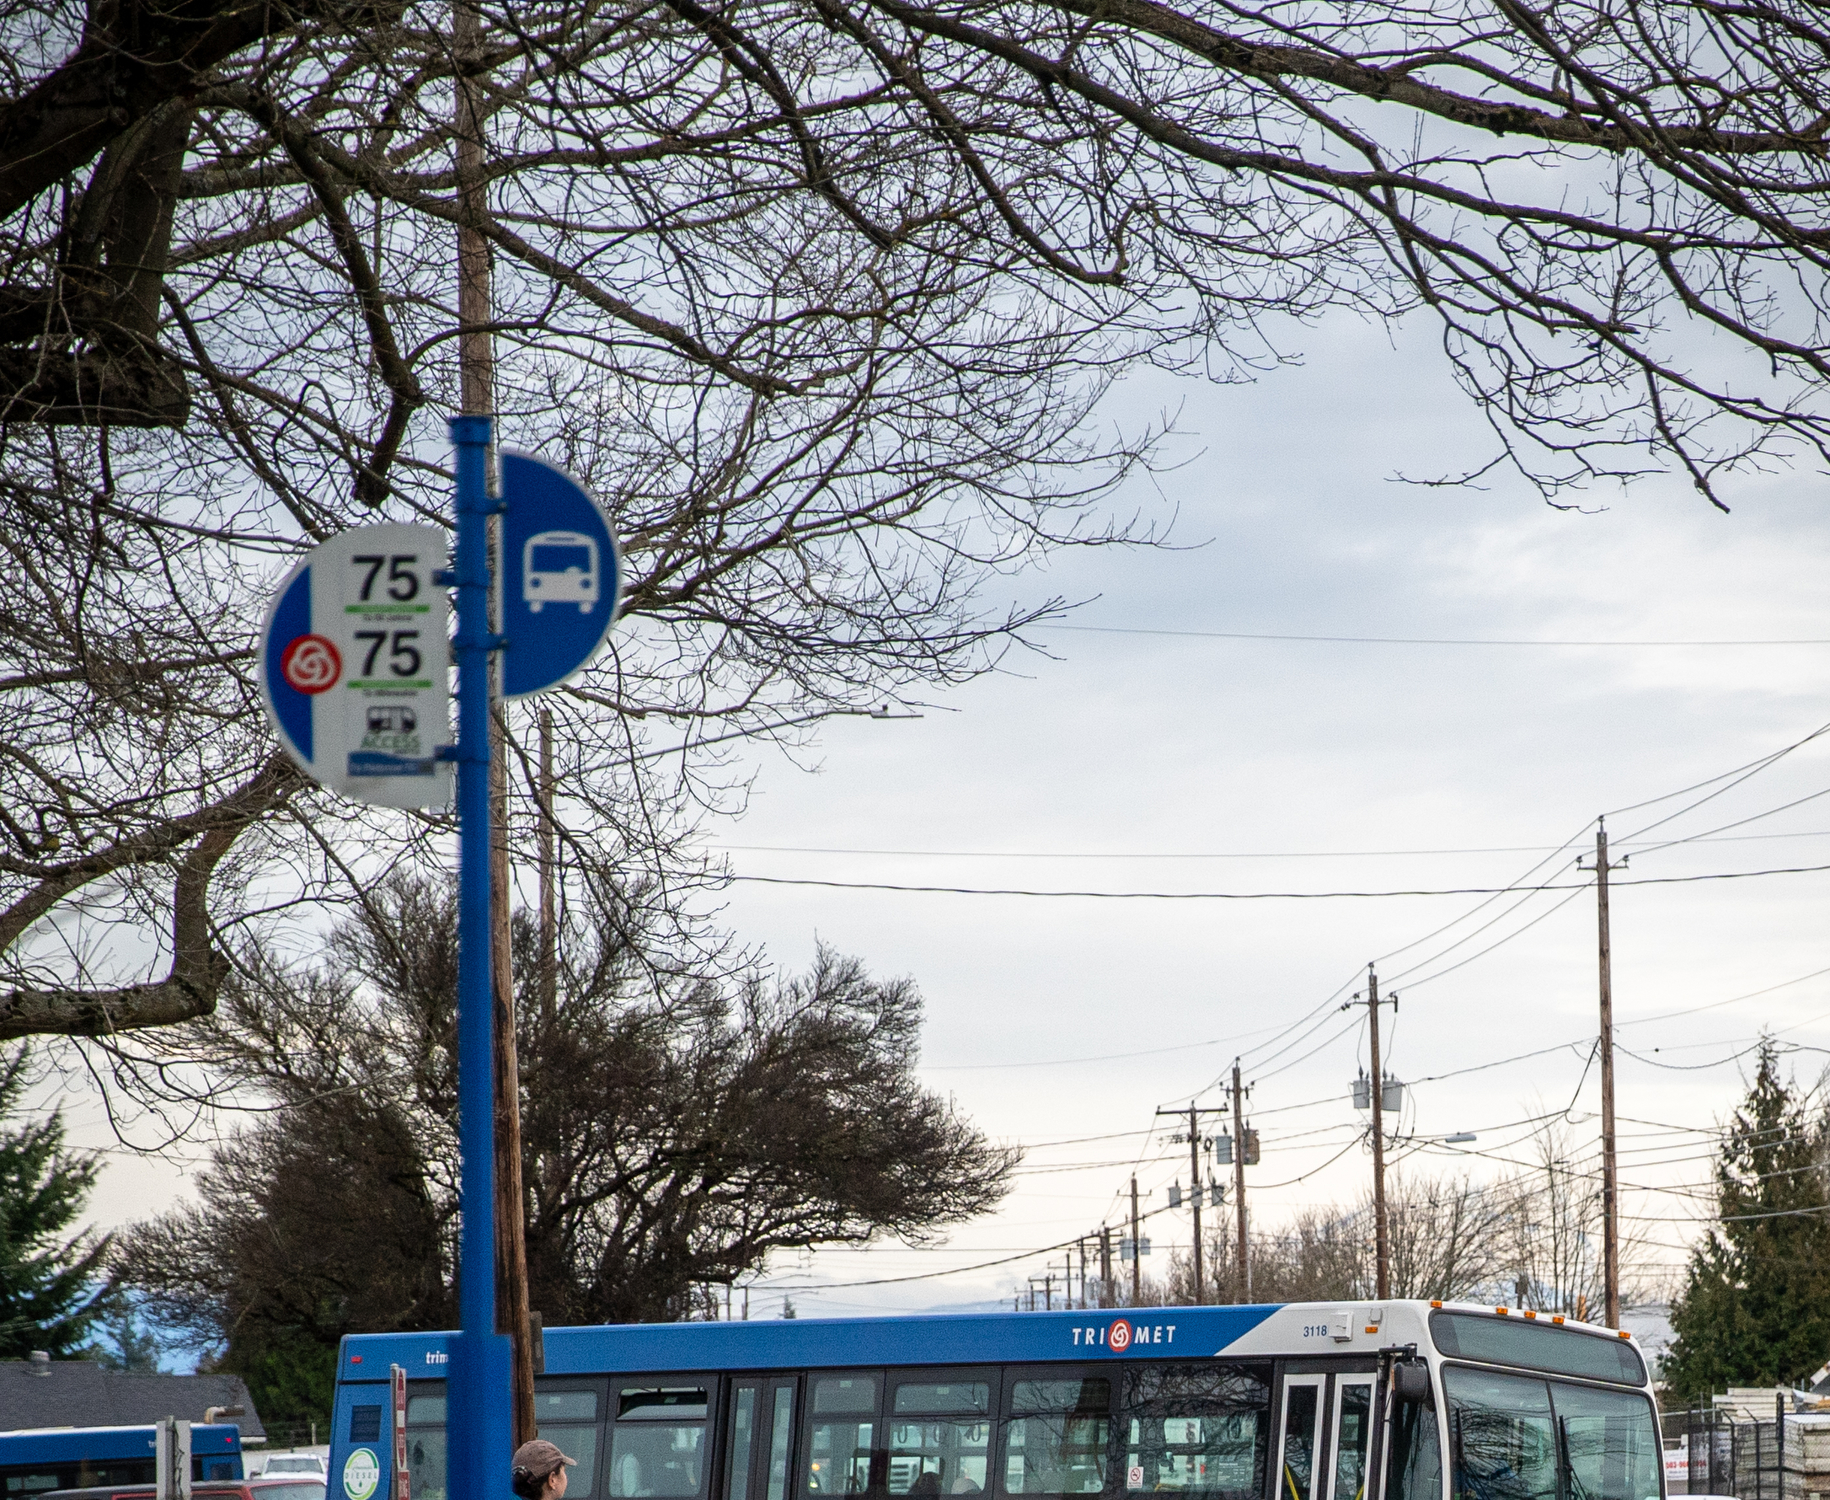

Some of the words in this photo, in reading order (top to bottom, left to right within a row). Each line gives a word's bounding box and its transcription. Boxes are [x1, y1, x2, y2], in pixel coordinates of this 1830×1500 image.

[352, 555, 419, 601] 75
[354, 630, 421, 676] 75
[1072, 1327, 1105, 1345] TRI
[1134, 1325, 1176, 1344] MET
[1303, 1325, 1327, 1337] 3118
[426, 1350, 449, 1364] trim
